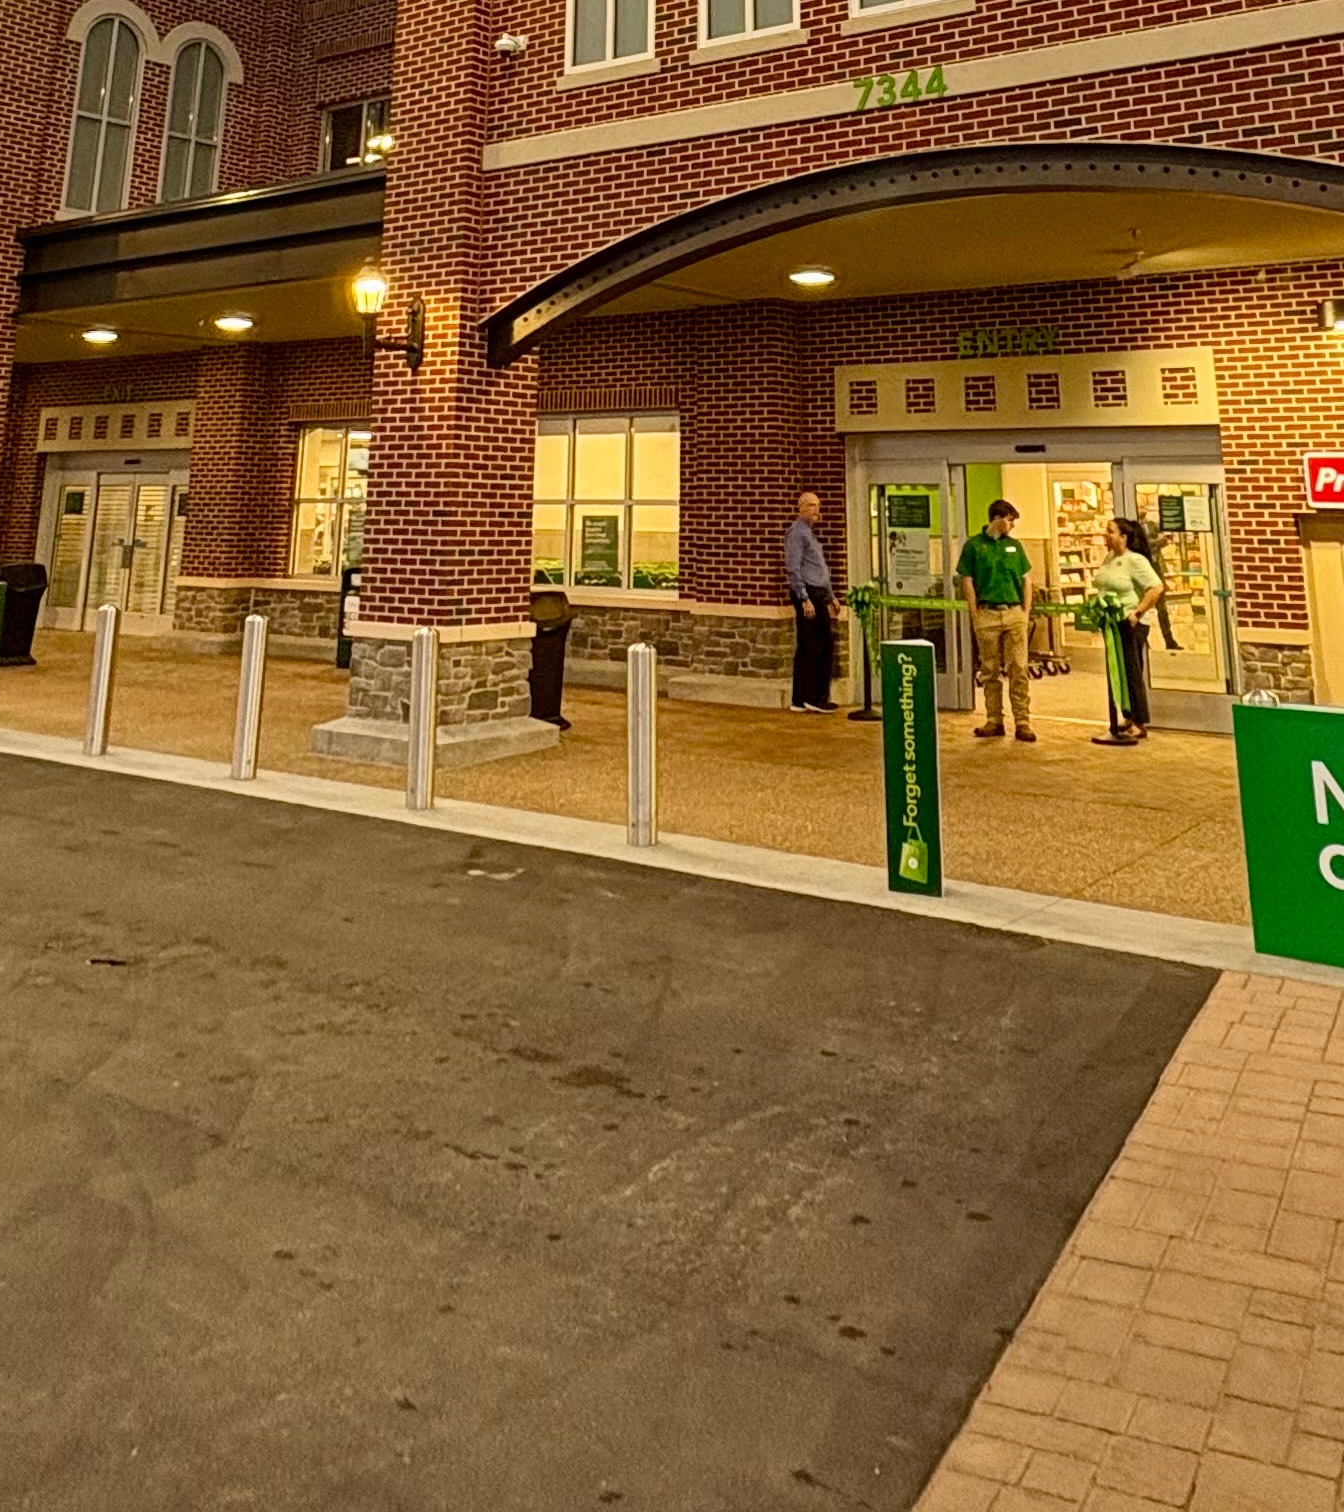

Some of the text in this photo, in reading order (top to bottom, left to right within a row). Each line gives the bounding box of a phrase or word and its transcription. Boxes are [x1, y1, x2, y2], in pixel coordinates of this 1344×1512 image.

[853, 65, 948, 111] 7344
[959, 327, 1058, 356] ENTRY
[898, 653, 921, 827] Forget something?
